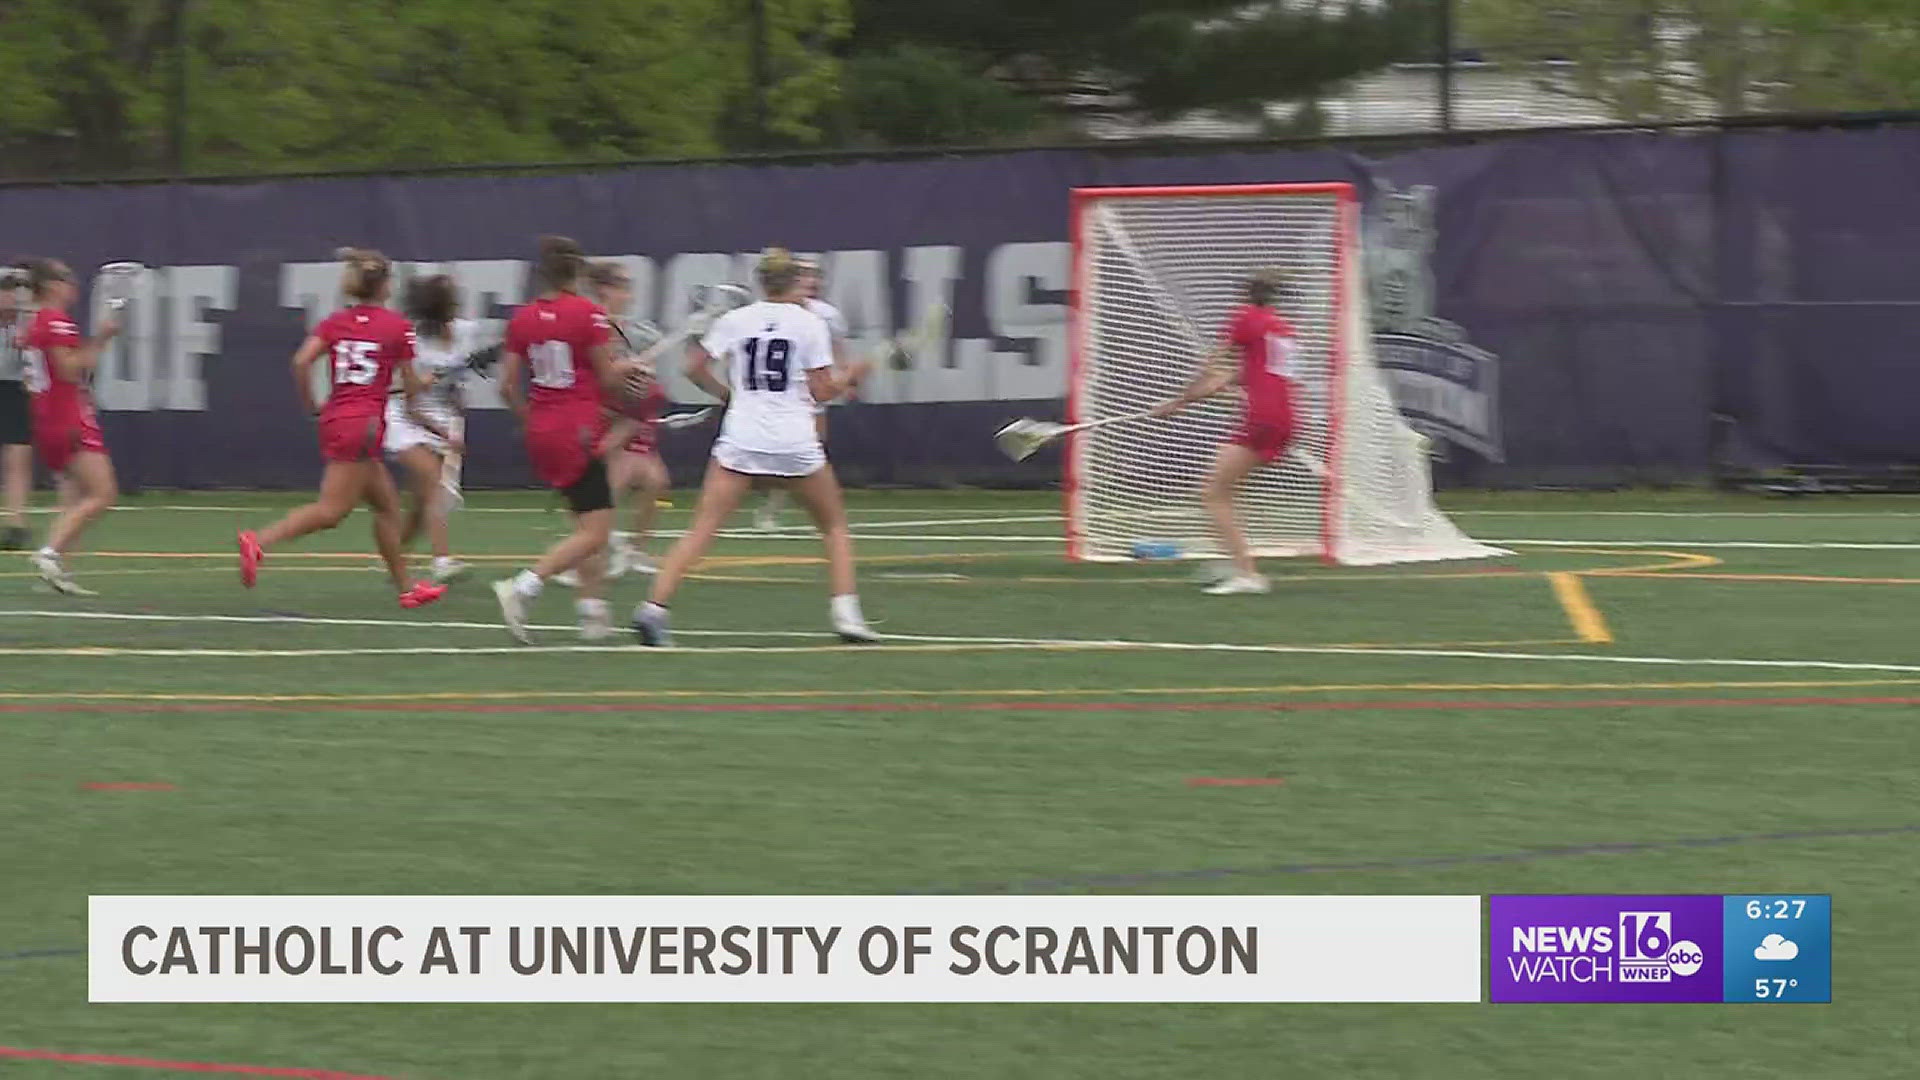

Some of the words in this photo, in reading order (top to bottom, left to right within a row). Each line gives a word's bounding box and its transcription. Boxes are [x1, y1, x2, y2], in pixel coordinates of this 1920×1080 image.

[90, 265, 240, 412] OF
[280, 259, 531, 410] TE
[334, 339, 383, 385] 15
[744, 336, 795, 393] 19
